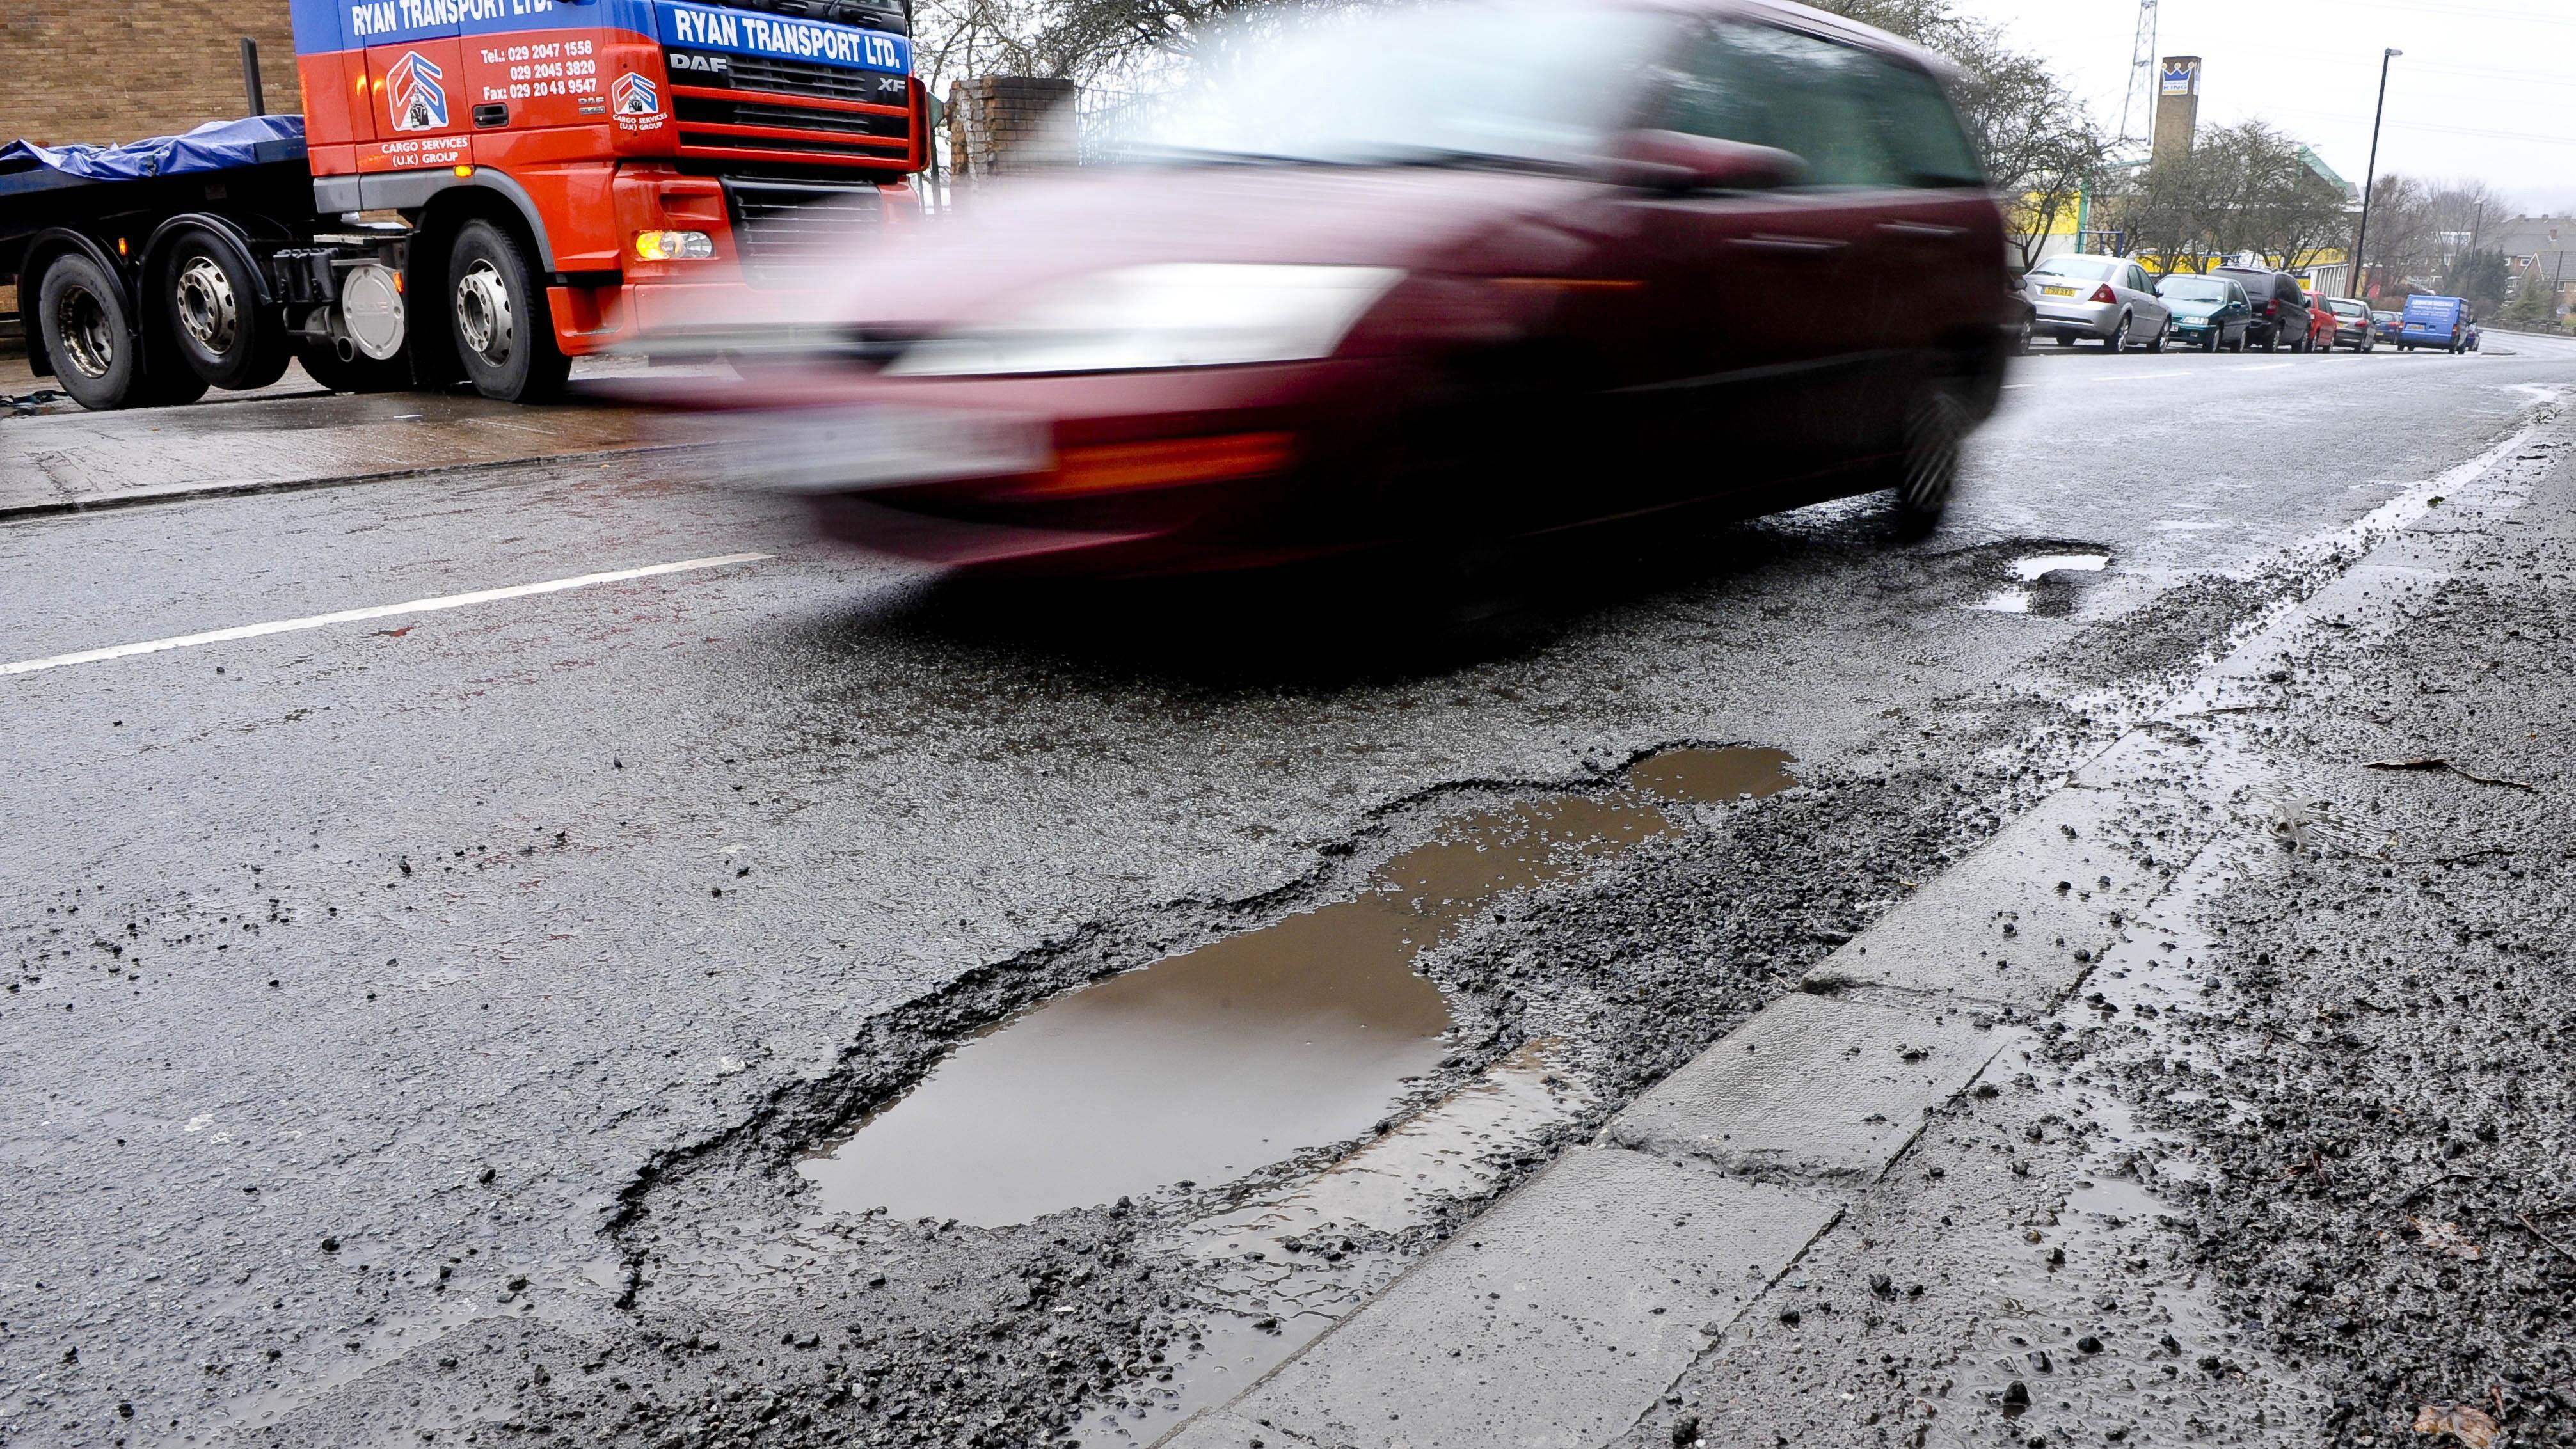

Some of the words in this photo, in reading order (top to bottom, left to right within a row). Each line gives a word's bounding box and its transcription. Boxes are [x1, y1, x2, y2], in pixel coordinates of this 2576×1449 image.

[352, 1, 397, 36] RYAN
[399, 0, 505, 29] TRANSPORT
[674, 8, 738, 47] RYAN
[742, 17, 860, 63] TRANSPORT
[864, 35, 900, 68] LTD.
[507, 45, 529, 61] 029
[532, 43, 560, 59] 2047
[564, 40, 593, 56] 1558
[509, 65, 532, 81] 029
[534, 63, 563, 79] 2045
[566, 59, 596, 76] 3820
[669, 53, 727, 72] DAF
[483, 86, 507, 100] Fax:
[509, 83, 531, 99] 029
[568, 77, 597, 94] 9547
[877, 77, 906, 93] XF
[578, 97, 605, 105] DAF
[612, 114, 637, 123] CARGO
[638, 112, 668, 123] SERVICES
[639, 122, 663, 131] GROUP
[381, 141, 418, 154] CARGO
[421, 137, 468, 151] SERVICES
[392, 153, 418, 168] (U.K)
[422, 151, 459, 164] GROUP
